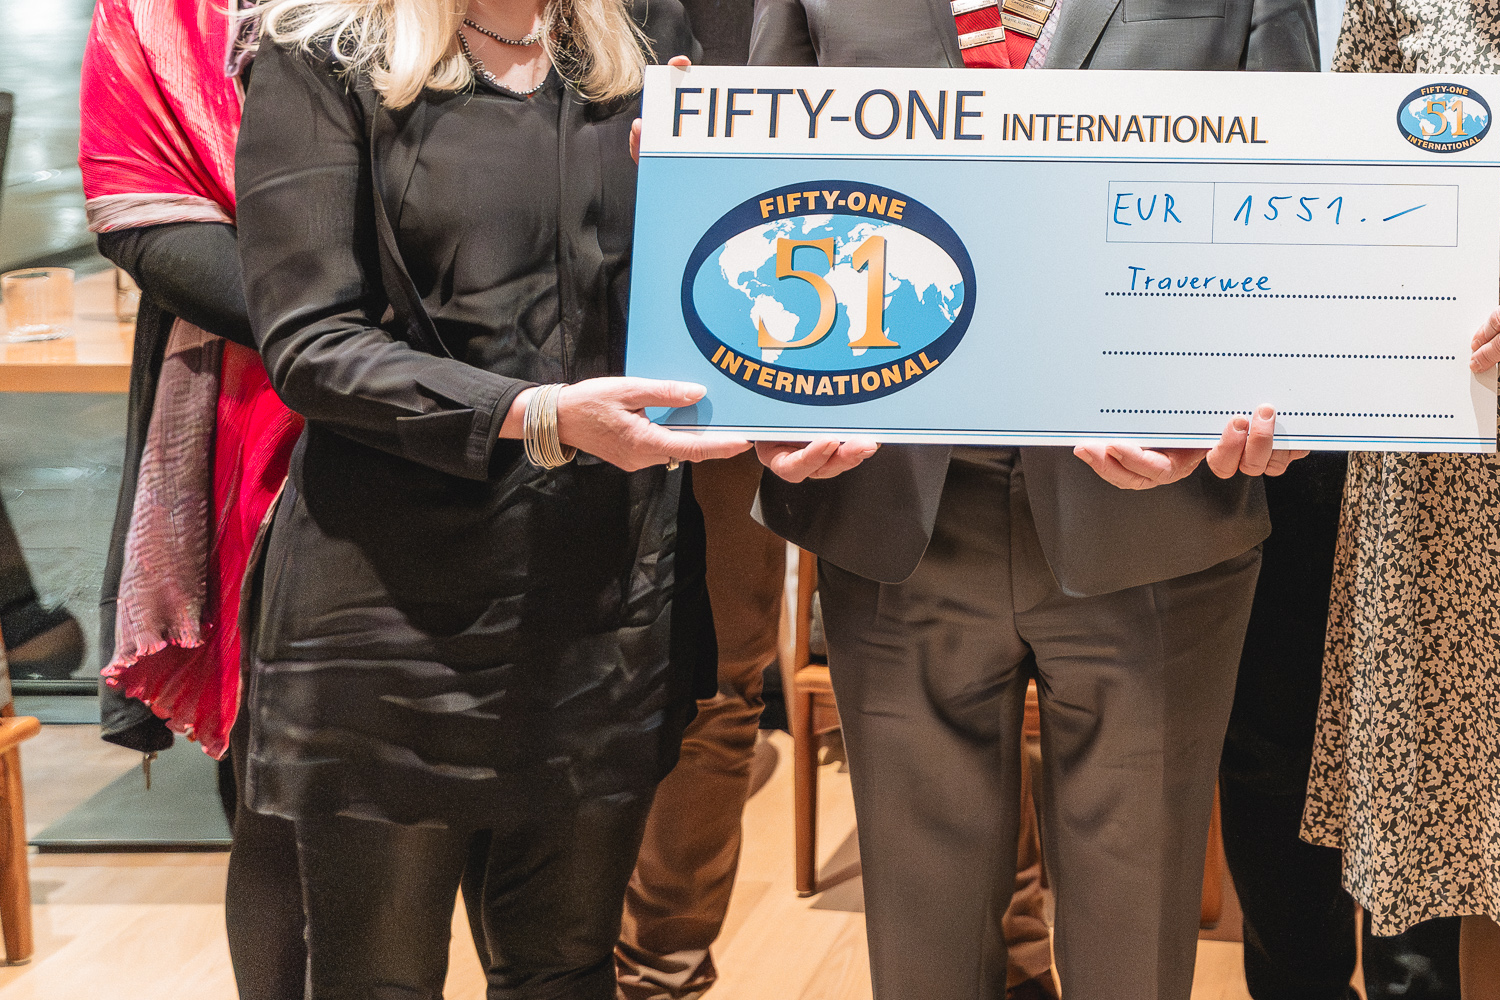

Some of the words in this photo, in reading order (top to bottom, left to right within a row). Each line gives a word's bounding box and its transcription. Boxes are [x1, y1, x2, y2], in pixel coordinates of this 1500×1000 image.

[1420, 85, 1470, 96] FIFTY-ONE
[672, 87, 986, 141] FIFTY-ONE
[1002, 113, 1269, 144] INTERNATIONAL
[1422, 100, 1468, 136] 51
[1406, 134, 1481, 151] INTERNATIONAL
[758, 190, 907, 220] FIFTY-ONE
[1113, 192, 1182, 226] EUR
[757, 235, 900, 349] 51
[710, 345, 940, 397] INTERNATIONAL
